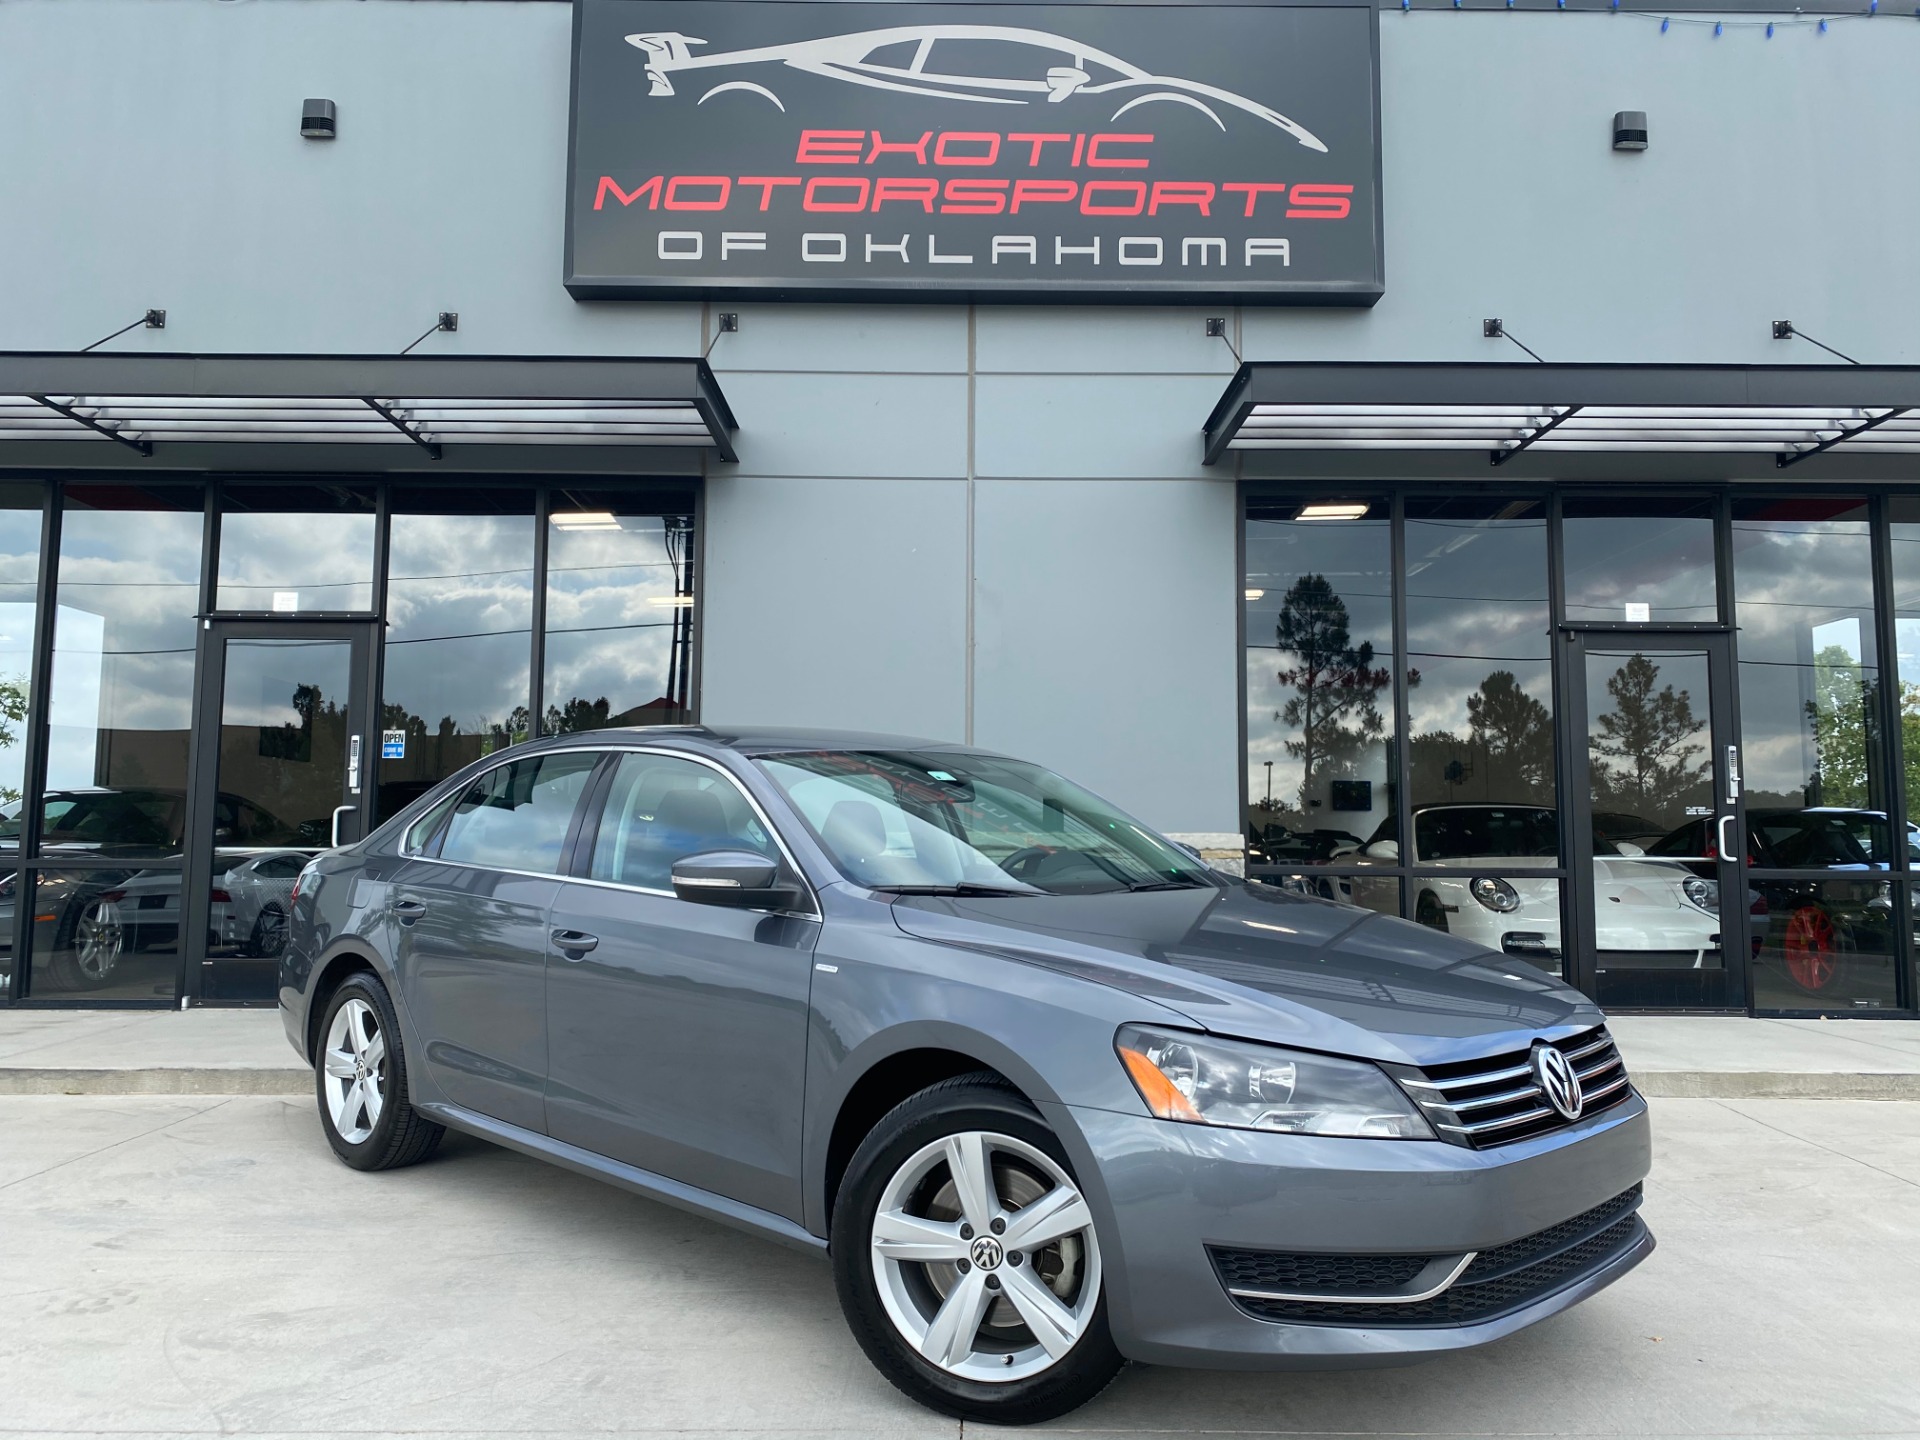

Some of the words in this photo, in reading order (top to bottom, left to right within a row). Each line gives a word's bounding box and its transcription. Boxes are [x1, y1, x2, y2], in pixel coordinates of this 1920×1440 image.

[796, 130, 1154, 168] EXOTIC
[593, 176, 1354, 218] MOTORSPORTS
[657, 231, 767, 260] OF
[801, 232, 1291, 267] OKLAHOMA
[384, 733, 403, 743] OPEN
